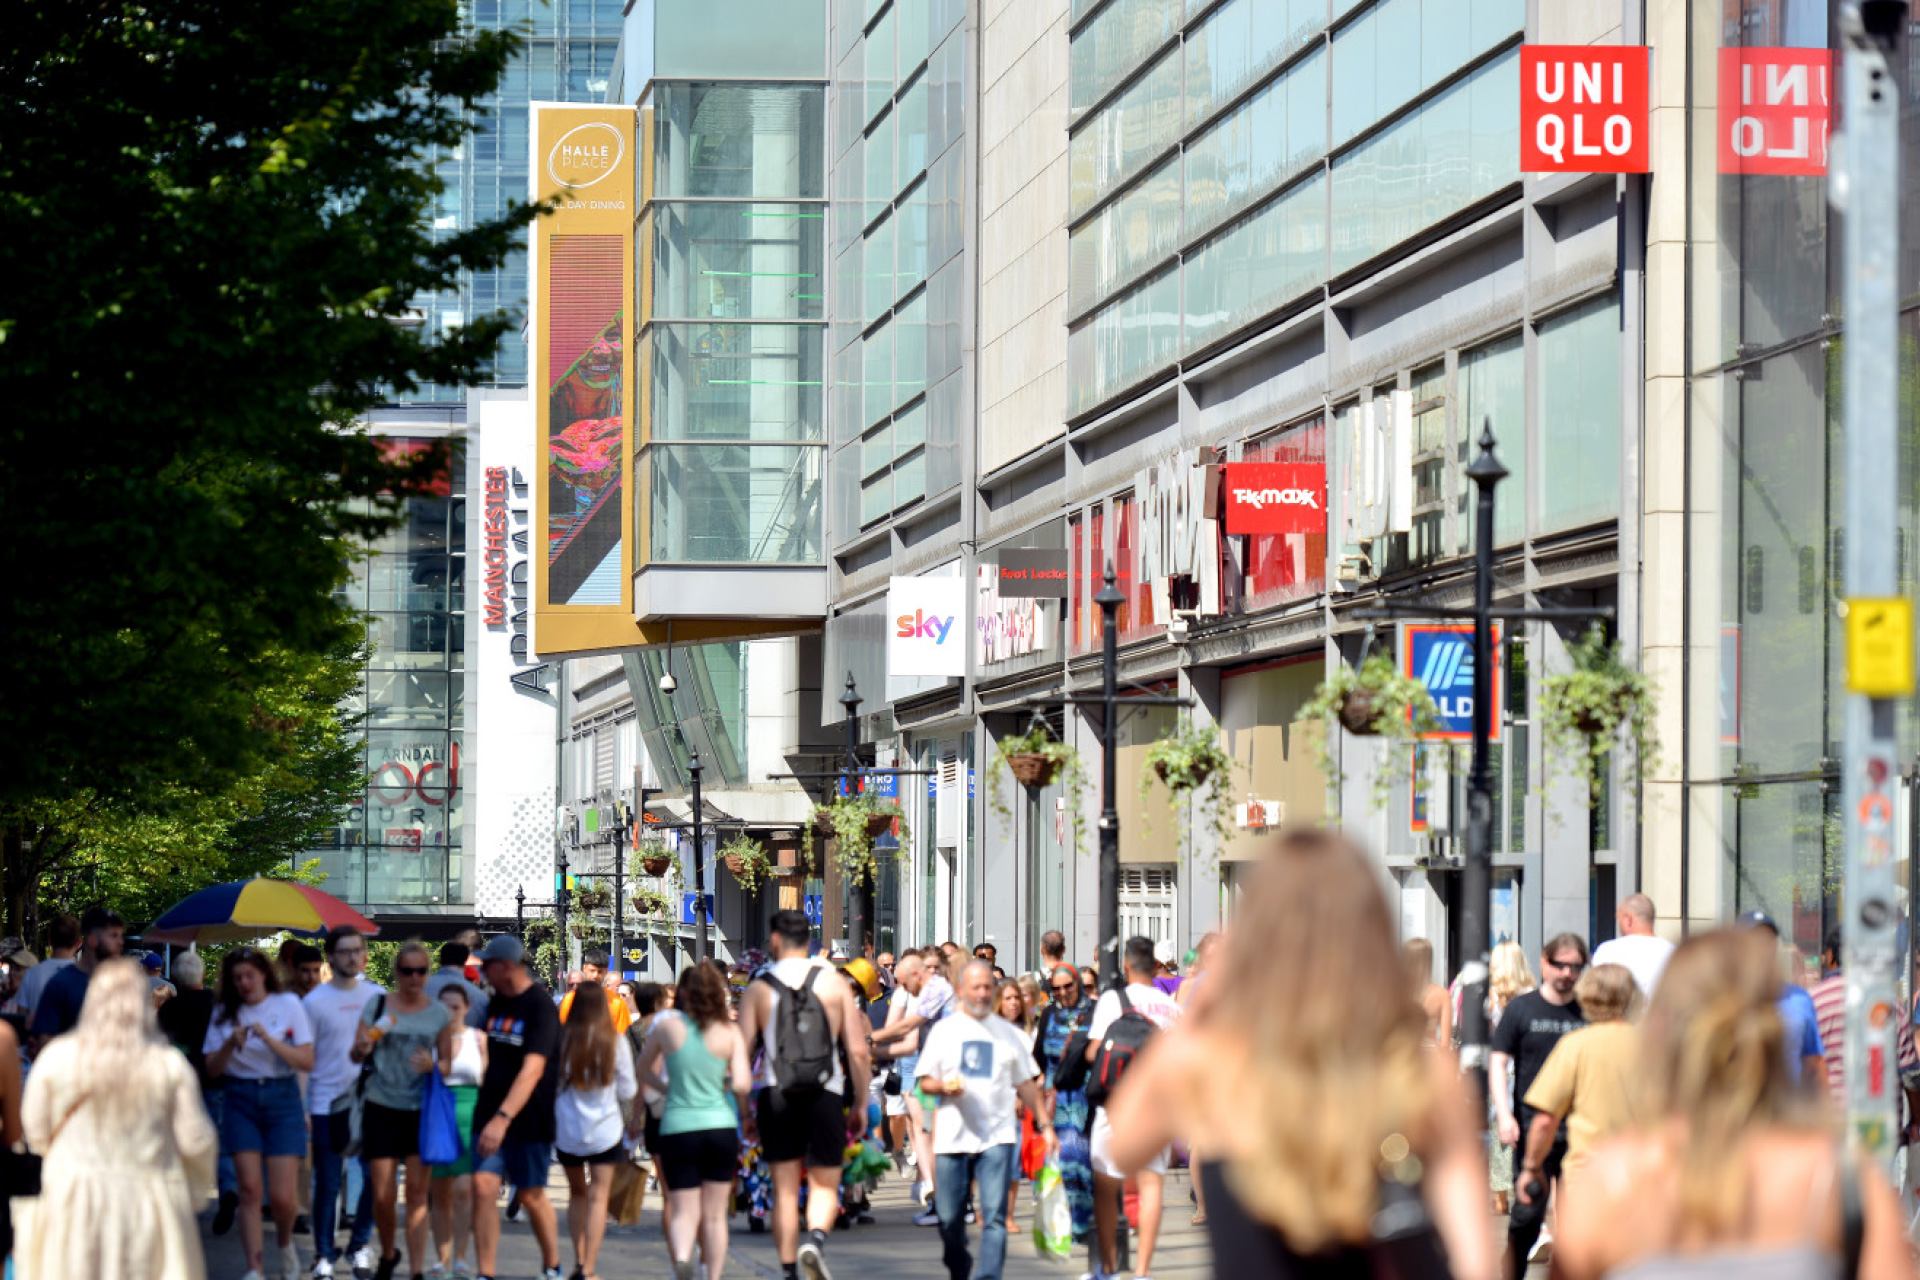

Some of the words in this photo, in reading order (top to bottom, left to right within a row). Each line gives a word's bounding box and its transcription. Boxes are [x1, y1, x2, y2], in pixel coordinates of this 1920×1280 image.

[1536, 62, 1623, 104] UNI
[1536, 114, 1632, 163] QLO
[562, 145, 609, 157] HALLE
[562, 157, 609, 169] PLACE
[567, 200, 587, 209] DAY
[590, 200, 625, 210] DINING
[484, 466, 507, 625] MANCHESTER
[1001, 567, 1027, 580] Foot
[1031, 567, 1068, 580] Locke
[896, 608, 955, 645] sky
[346, 807, 456, 825] OURT
[387, 834, 418, 846] KFC
